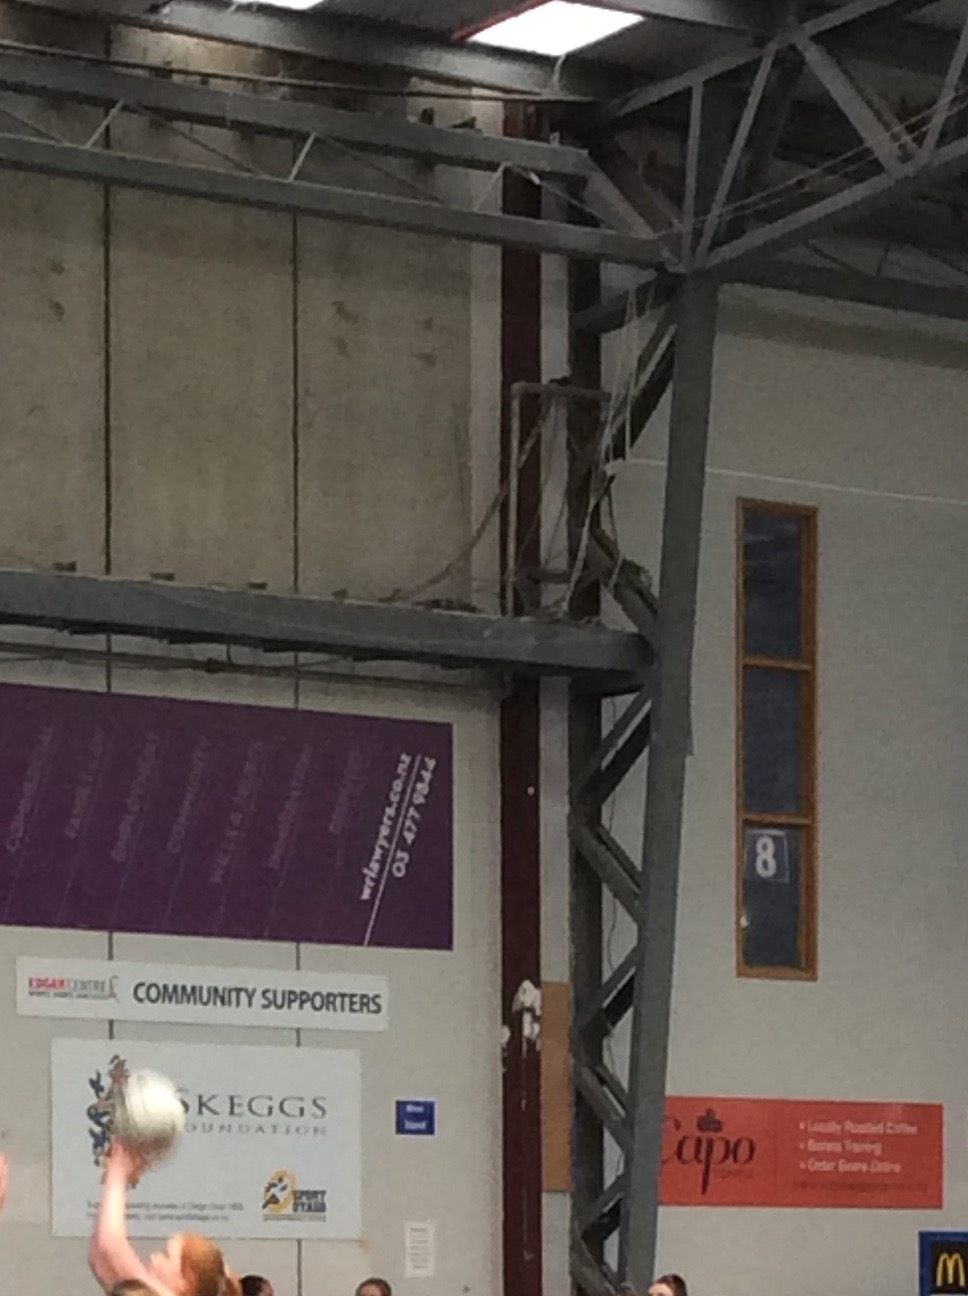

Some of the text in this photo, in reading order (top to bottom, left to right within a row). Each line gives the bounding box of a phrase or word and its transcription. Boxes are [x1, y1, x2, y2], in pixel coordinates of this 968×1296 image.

[391, 849, 410, 878] 03
[403, 806, 421, 845] 477
[755, 836, 777, 878] 8
[133, 982, 383, 1015] COMMUNITY SUPPORTERS
[183, 1122, 327, 1136] OUNDATION
